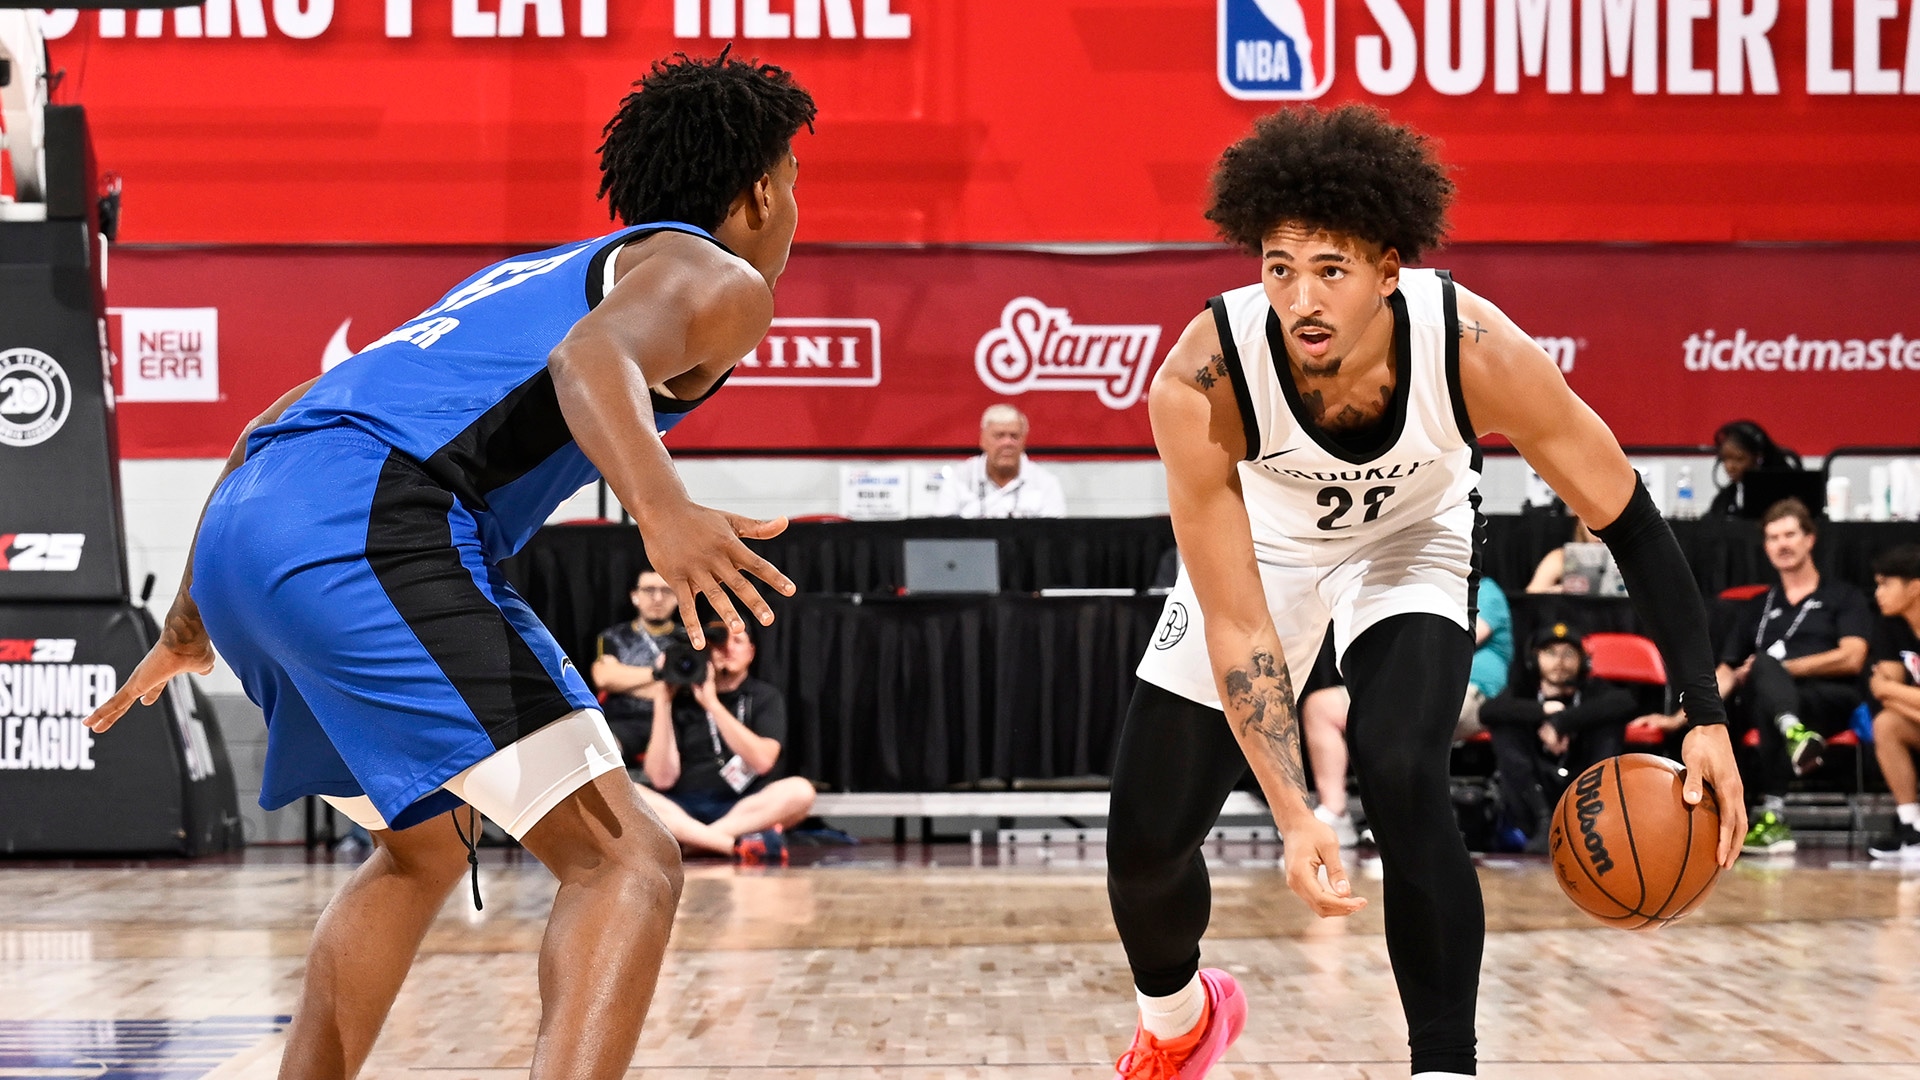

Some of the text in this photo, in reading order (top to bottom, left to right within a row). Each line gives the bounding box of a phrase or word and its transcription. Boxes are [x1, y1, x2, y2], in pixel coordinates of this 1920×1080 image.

[1235, 40, 1291, 82] NBA
[138, 331, 202, 353] NEW
[737, 335, 860, 368] INI
[980, 302, 1155, 403] Starry
[139, 356, 202, 379] ERA
[1576, 764, 1615, 877] Wilson
